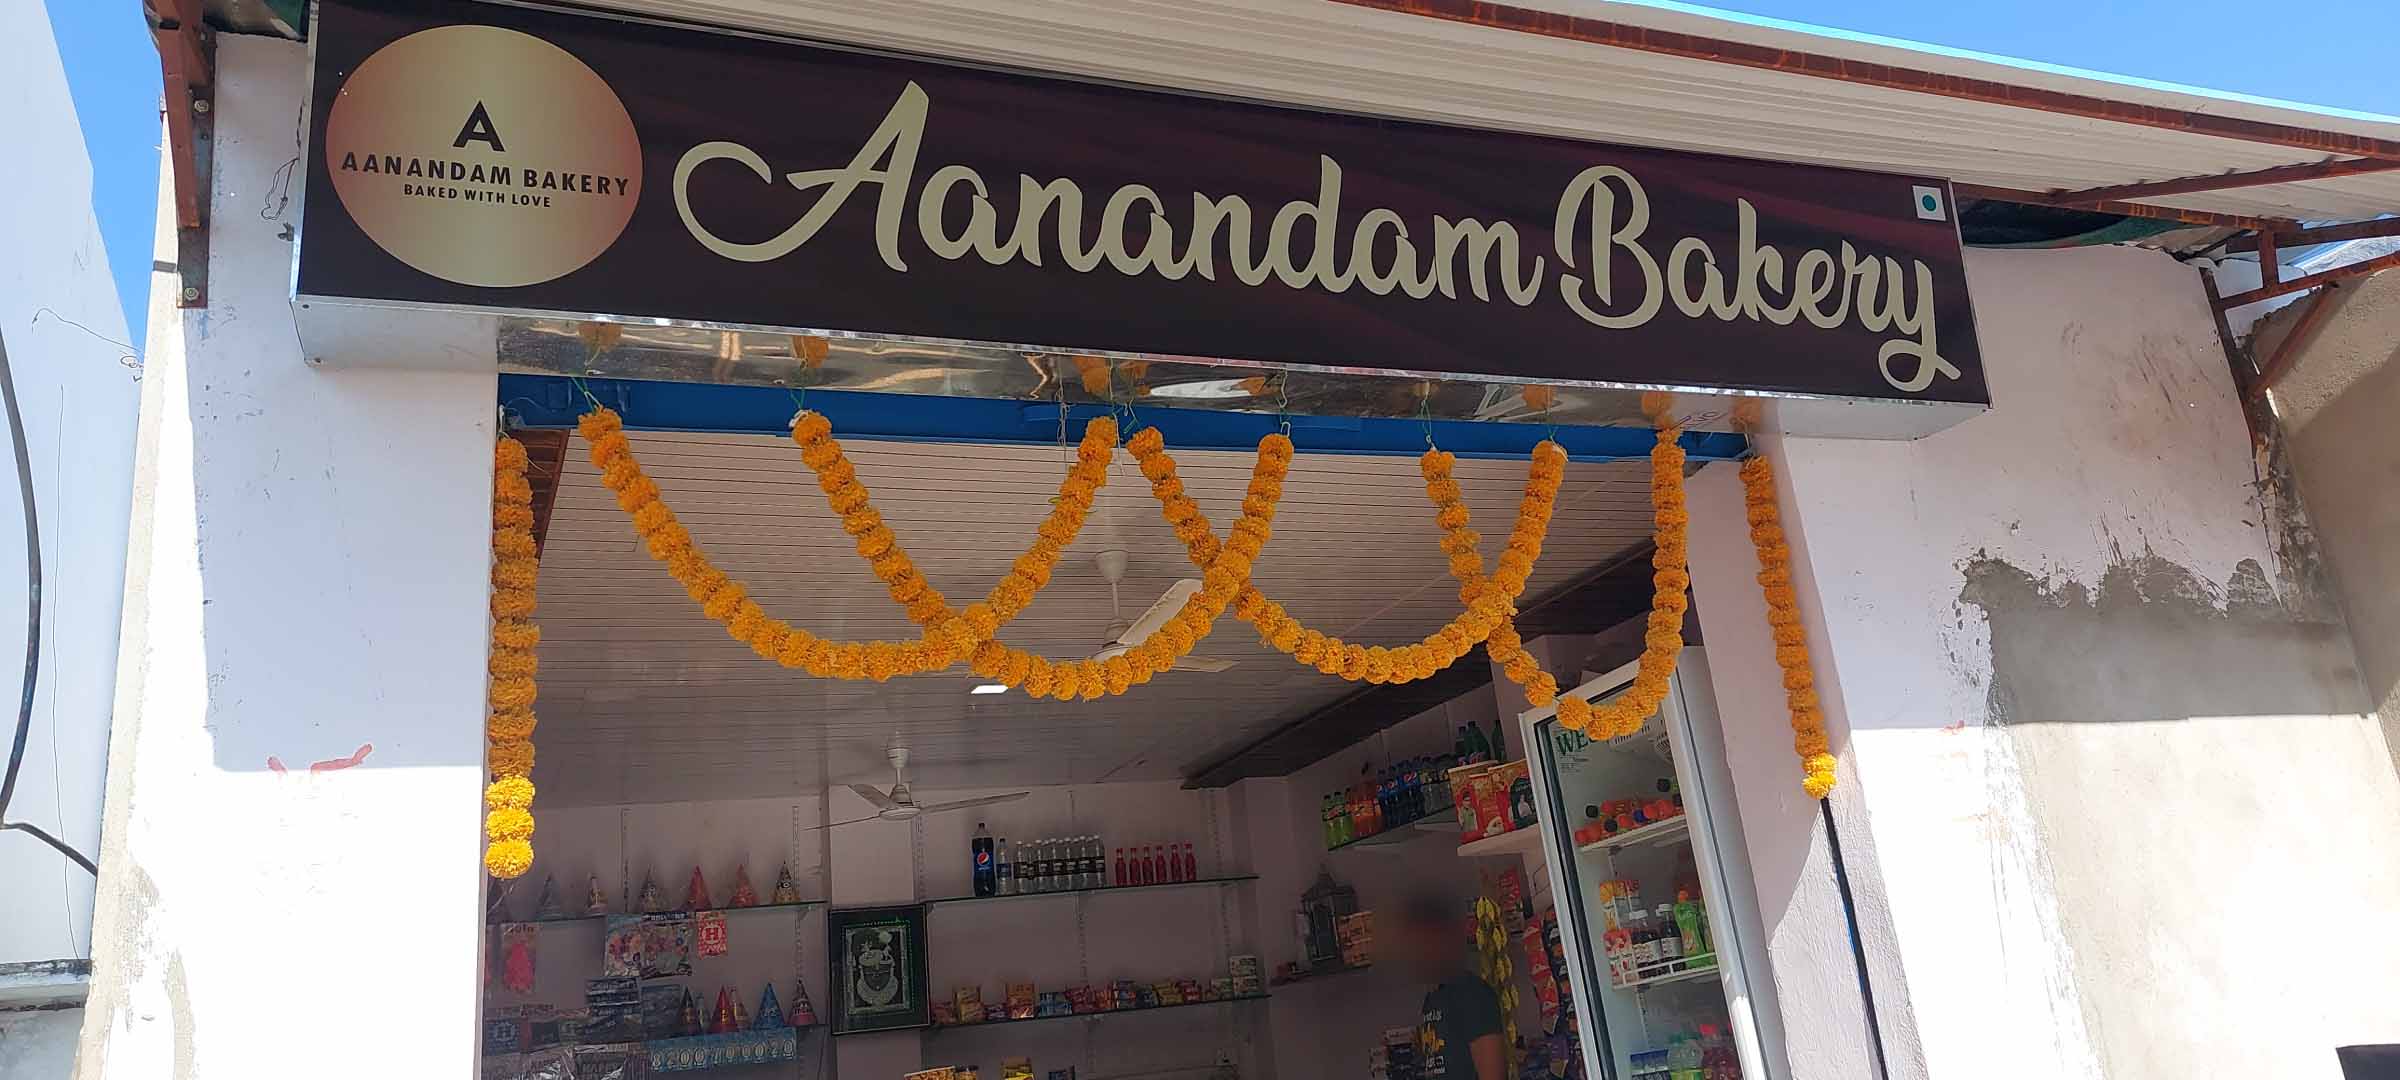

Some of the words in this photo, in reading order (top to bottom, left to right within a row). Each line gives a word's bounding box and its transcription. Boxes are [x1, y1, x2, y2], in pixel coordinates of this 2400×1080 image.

[452, 100, 506, 152] A
[341, 151, 511, 186] AANANDAM
[523, 168, 630, 196] BAKERY
[403, 183, 458, 199] BAKED
[464, 189, 505, 204] WITH
[511, 193, 551, 208] LOVE
[673, 81, 1545, 307] Aanandam
[1554, 164, 1961, 392] Bakery
